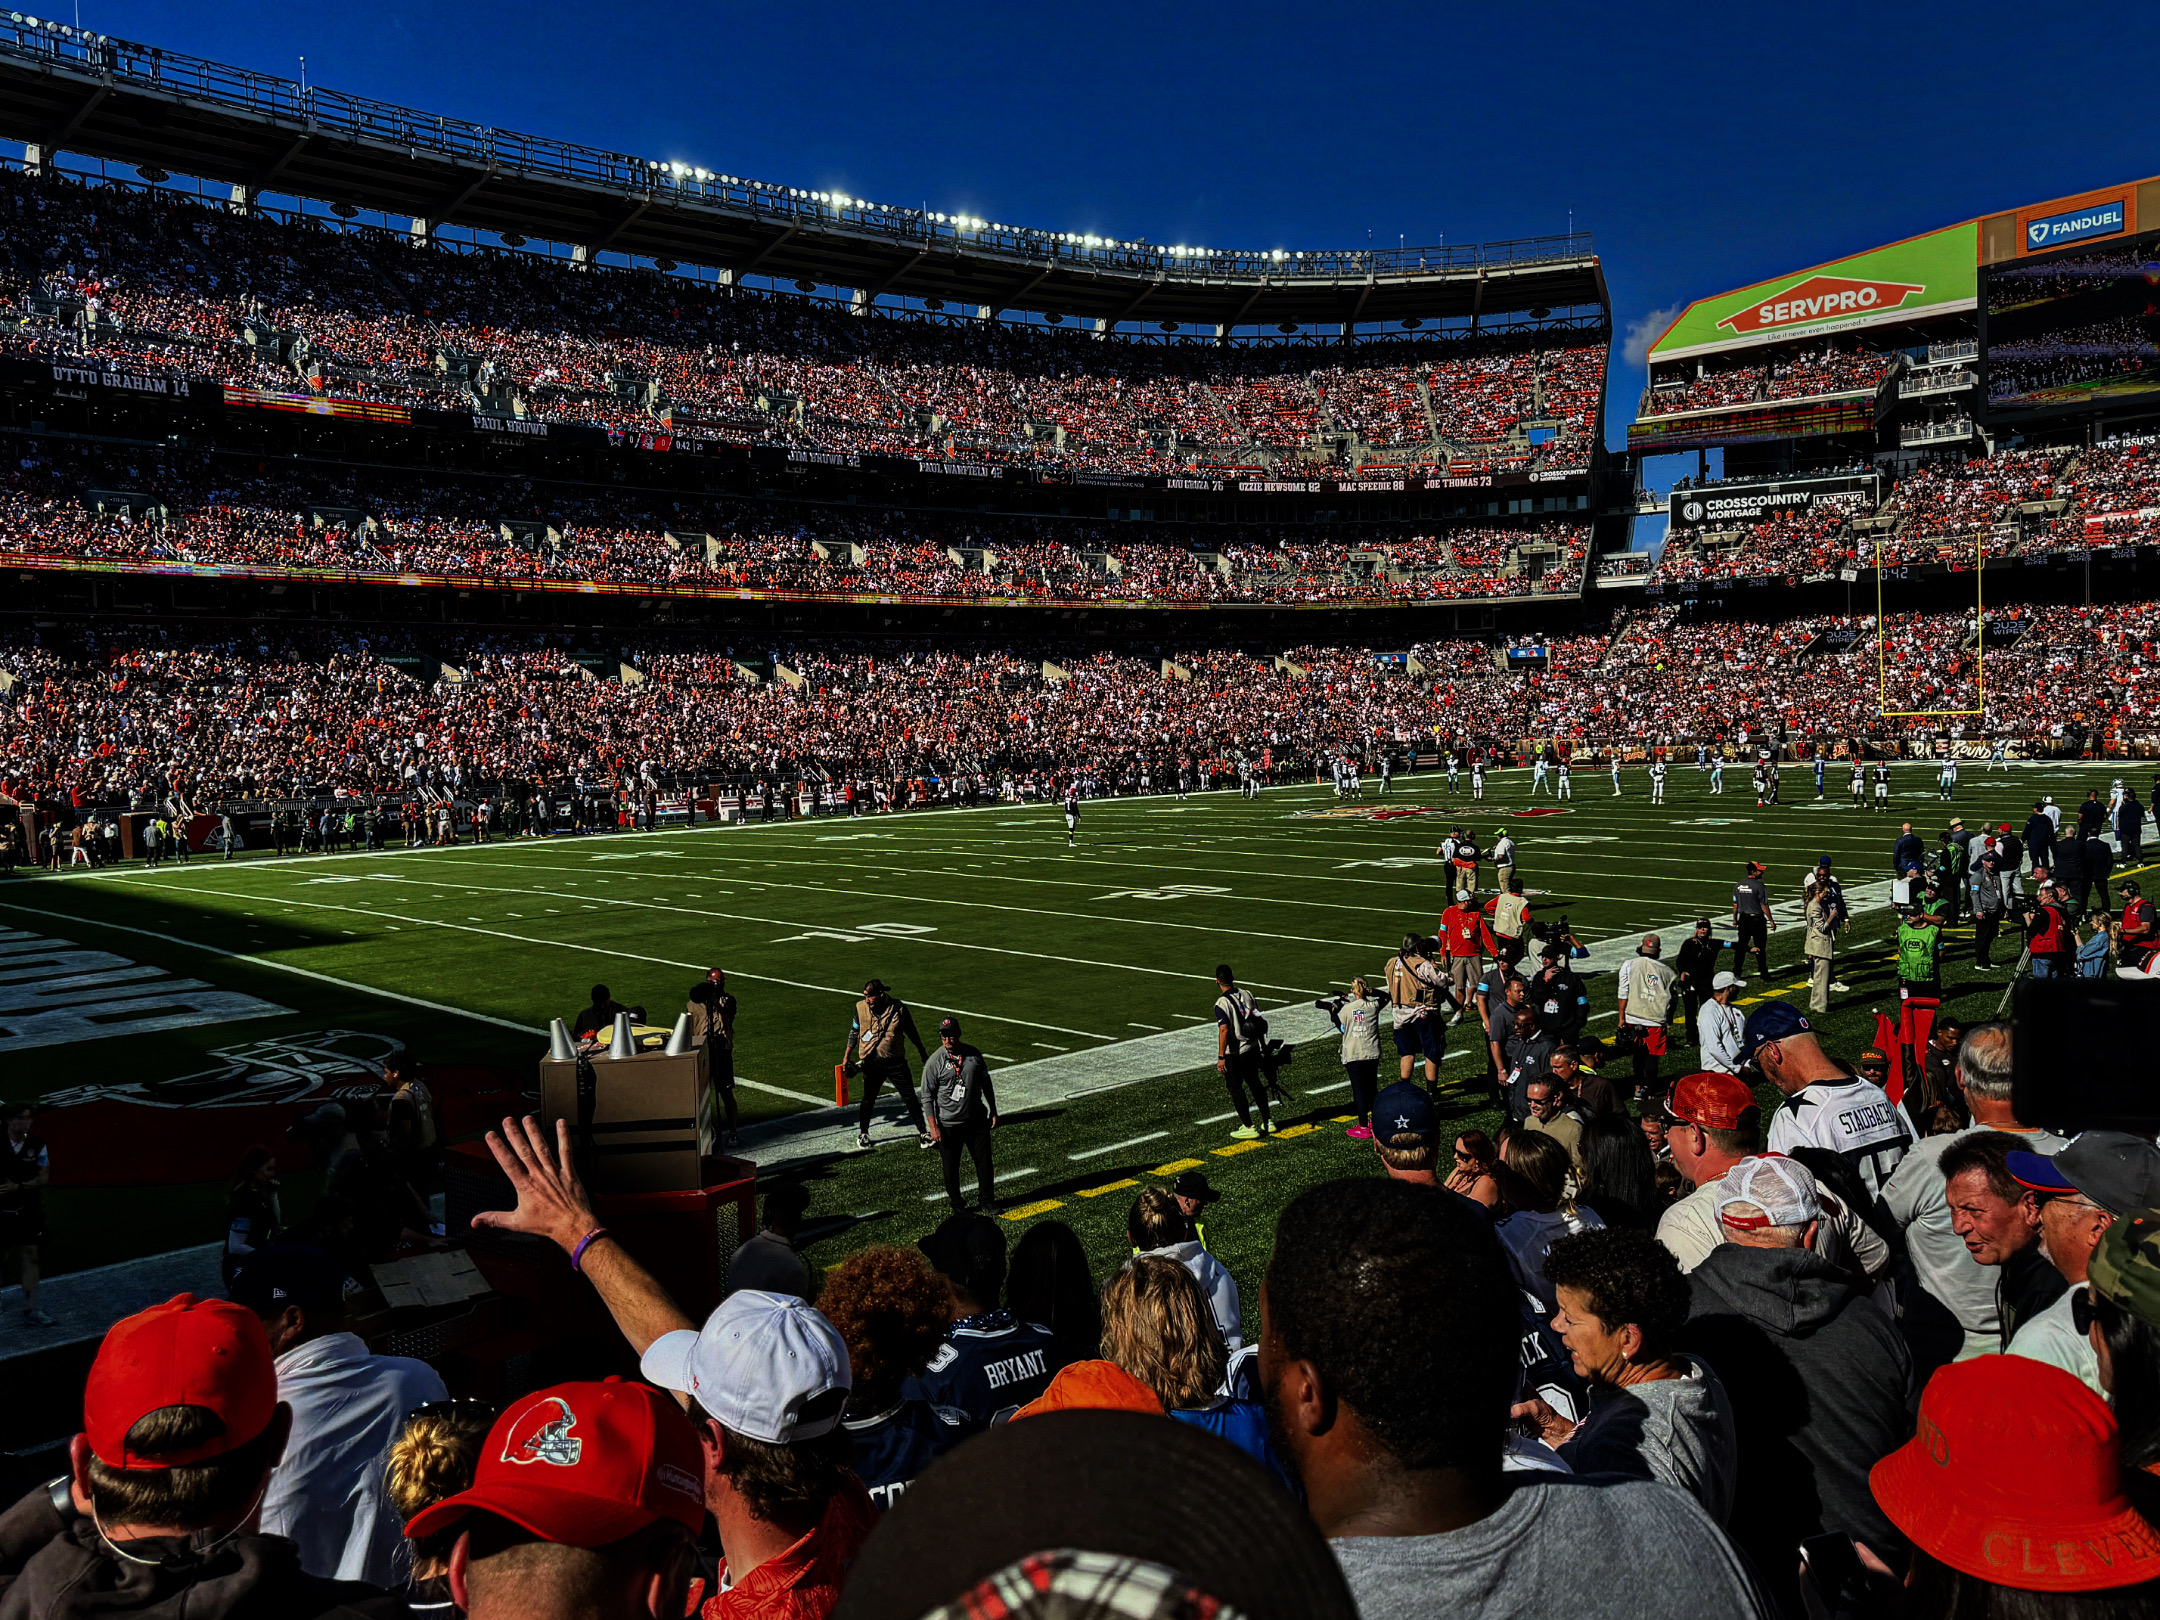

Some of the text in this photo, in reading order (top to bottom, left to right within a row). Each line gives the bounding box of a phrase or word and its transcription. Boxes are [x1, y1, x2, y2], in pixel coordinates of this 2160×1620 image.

[2052, 211, 2122, 236] FANDUEL
[1767, 333, 1781, 341] Like
[53, 366, 190, 397] OTTO GRAHAM 14
[472, 416, 548, 436] PAUL BROWN
[676, 440, 690, 450] 0:42
[2122, 435, 2156, 448] ISSUES
[787, 450, 861, 468] JIM BROWN 32
[919, 461, 1003, 479] PAUL WARFIELD 42
[1539, 469, 1588, 477] CROSSCOUNTRY
[1167, 478, 1183, 489] LOU
[1212, 481, 1224, 492] 76
[1239, 482, 1320, 492] OZZIE NEWSOME 82
[1339, 480, 1405, 492] MAC SPEEDIE 88
[1424, 476, 1492, 490] JOE THOMAS 73
[1706, 491, 1810, 511] CROSSCOUNTRY
[1706, 508, 1762, 520] MORTGAGE
[1880, 567, 1909, 581] 0:42
[1992, 621, 2026, 629] DUDE
[1993, 628, 2026, 636] WIPES
[1826, 629, 1857, 638] DUDE
[1826, 636, 1857, 644] WIPES
[1950, 740, 1992, 759] POUND
[1839, 1102, 1895, 1135] STAUBACH
[983, 1349, 1048, 1390] BRYANT
